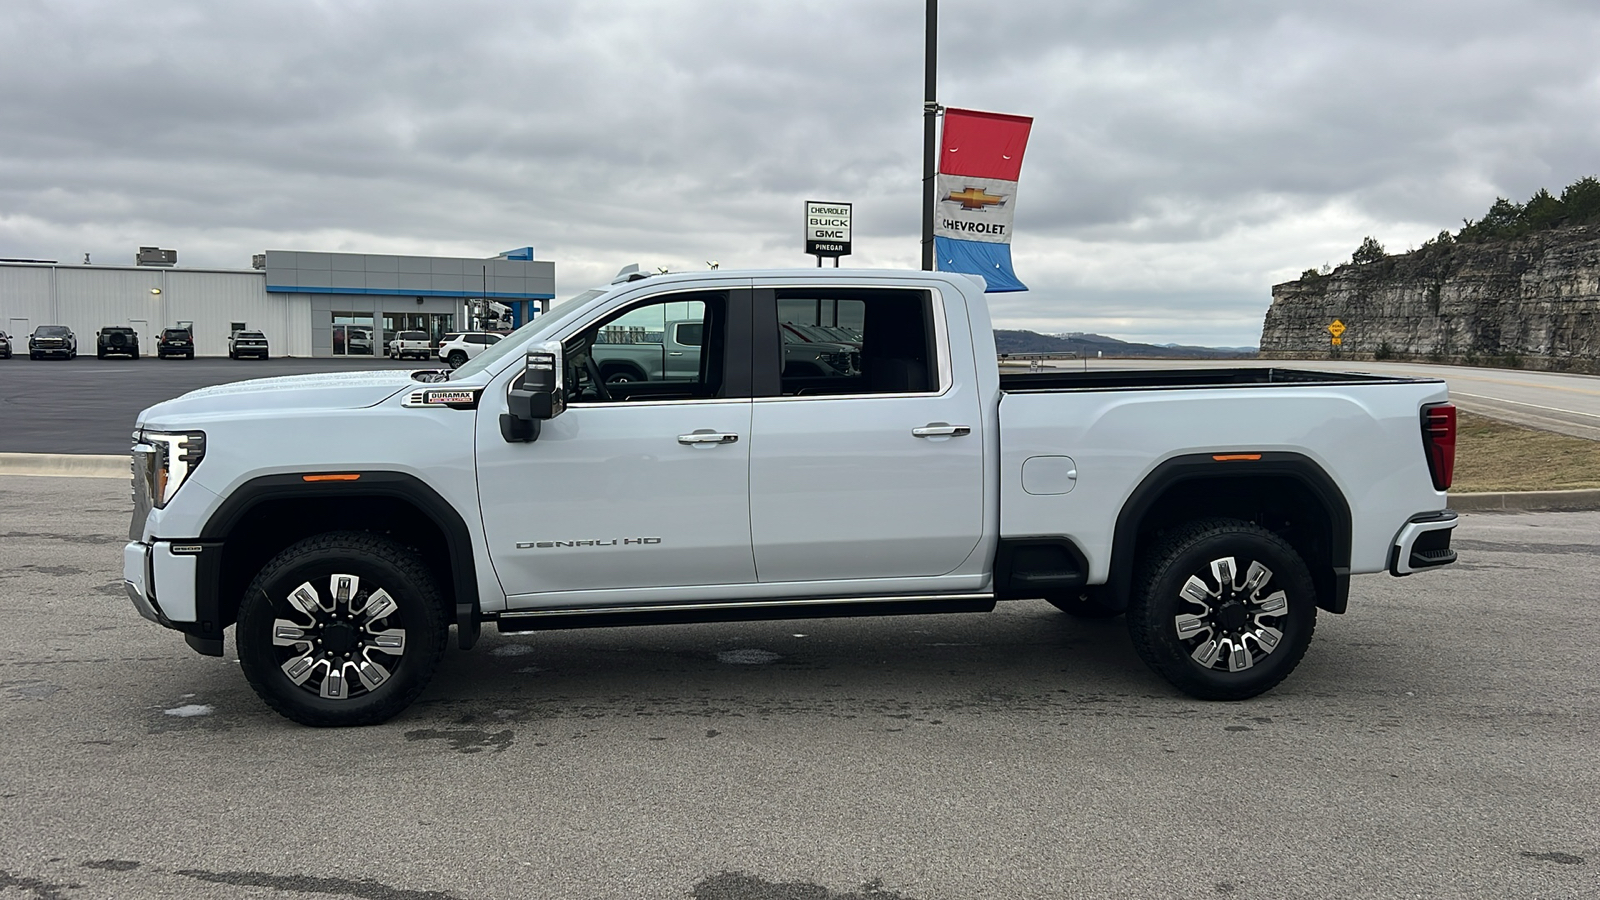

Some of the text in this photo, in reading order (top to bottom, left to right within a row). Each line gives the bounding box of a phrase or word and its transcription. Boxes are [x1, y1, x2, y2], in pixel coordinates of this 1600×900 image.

[810, 218, 848, 226] BUICK
[516, 537, 661, 549] DENALI HD
